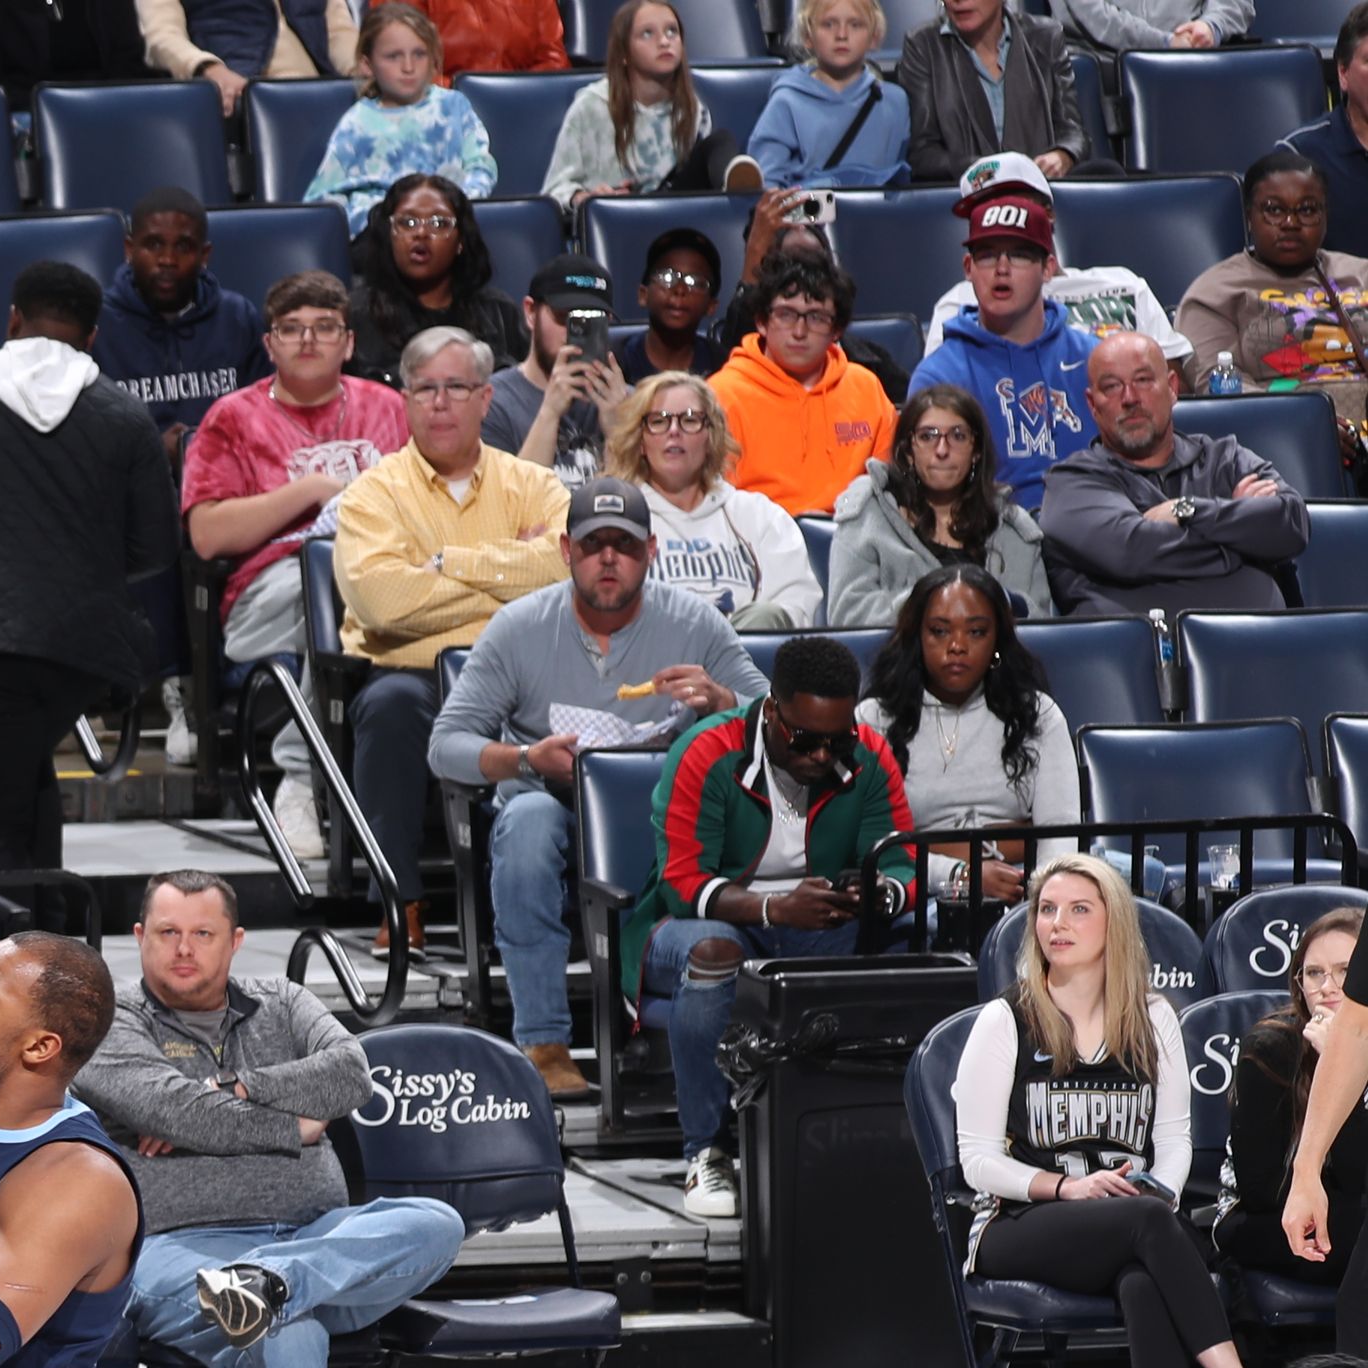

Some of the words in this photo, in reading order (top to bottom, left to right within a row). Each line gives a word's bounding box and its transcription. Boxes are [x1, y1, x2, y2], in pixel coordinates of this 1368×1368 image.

[982, 205, 1029, 229] 801
[1148, 963, 1196, 989] bin
[352, 1065, 477, 1126] Sissy's
[399, 1099, 448, 1133] Log
[451, 1095, 530, 1124] Cabin
[1026, 1081, 1153, 1155] MEMPHIS
